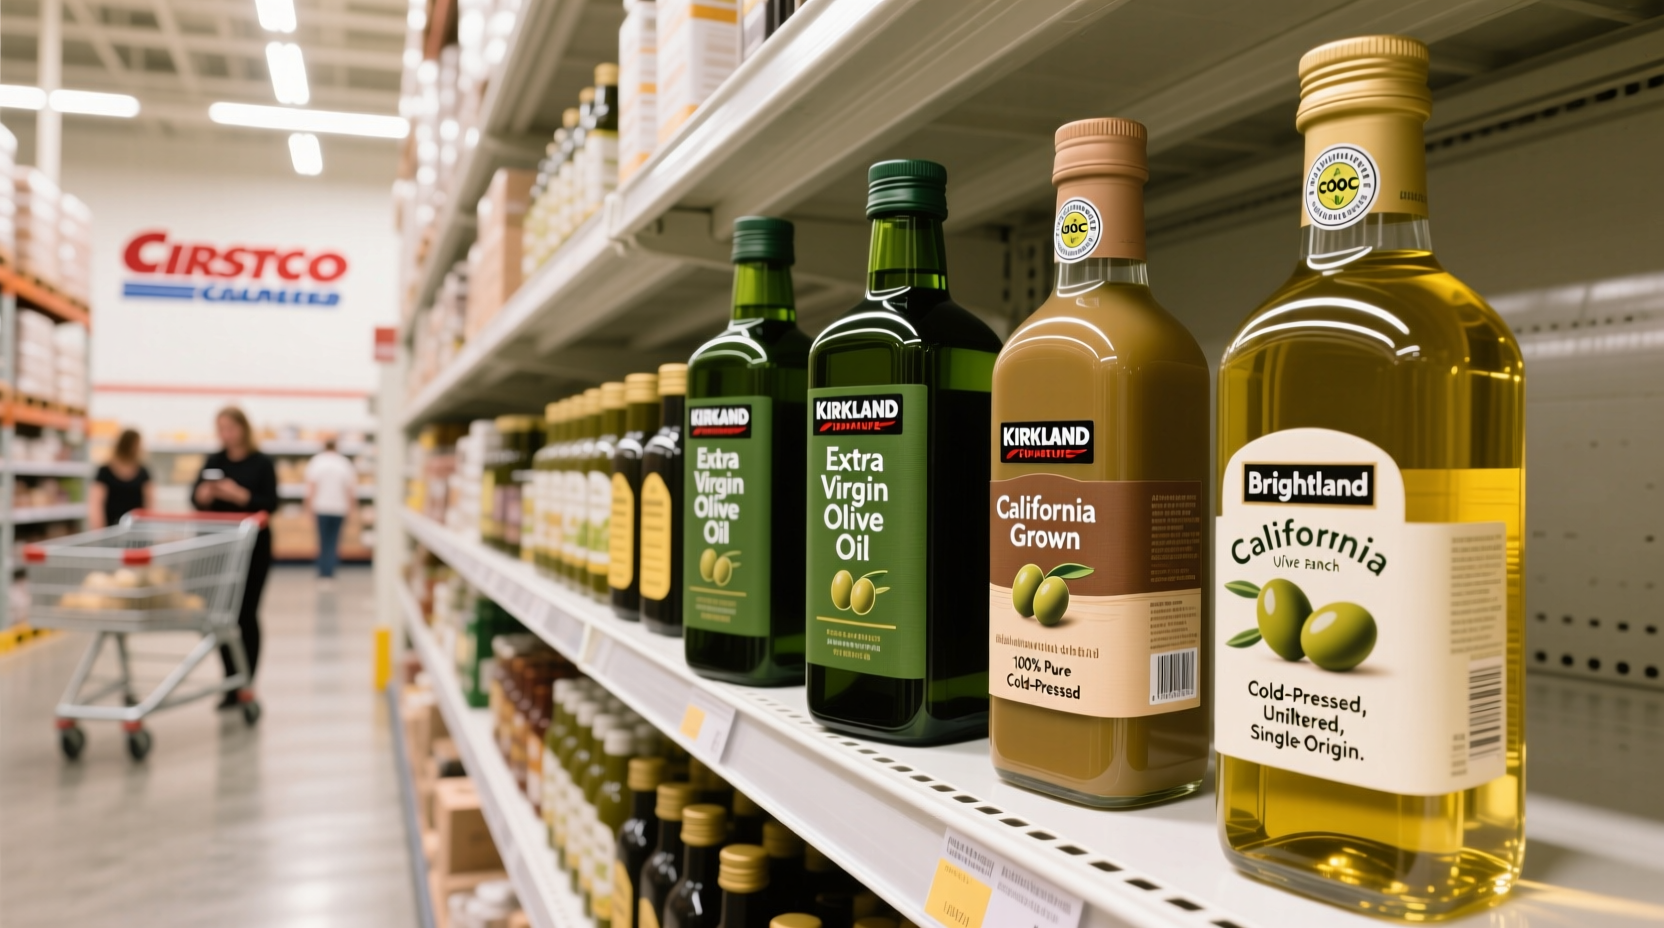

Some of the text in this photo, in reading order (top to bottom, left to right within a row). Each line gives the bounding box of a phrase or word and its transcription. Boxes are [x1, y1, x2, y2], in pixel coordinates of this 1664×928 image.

[123, 232, 348, 283] CIRSTCO
[816, 398, 899, 420] KIRKLAND
[1003, 426, 1090, 447] KIRKLAND
[696, 447, 740, 470] Extra
[826, 446, 884, 472] Extra
[693, 471, 745, 500] Virgin
[820, 474, 889, 508] Virgin
[1248, 470, 1369, 502] Brightland
[693, 494, 740, 521] Olive
[823, 503, 884, 532] Olive
[996, 494, 1096, 524] California
[703, 519, 730, 544] Oil
[1010, 522, 1080, 550] Grown
[835, 533, 870, 562] Oil
[1012, 655, 1072, 677] 100% Pure
[1248, 680, 1367, 718] Cold-Pressed,
[1250, 723, 1365, 762] Single Origin.
